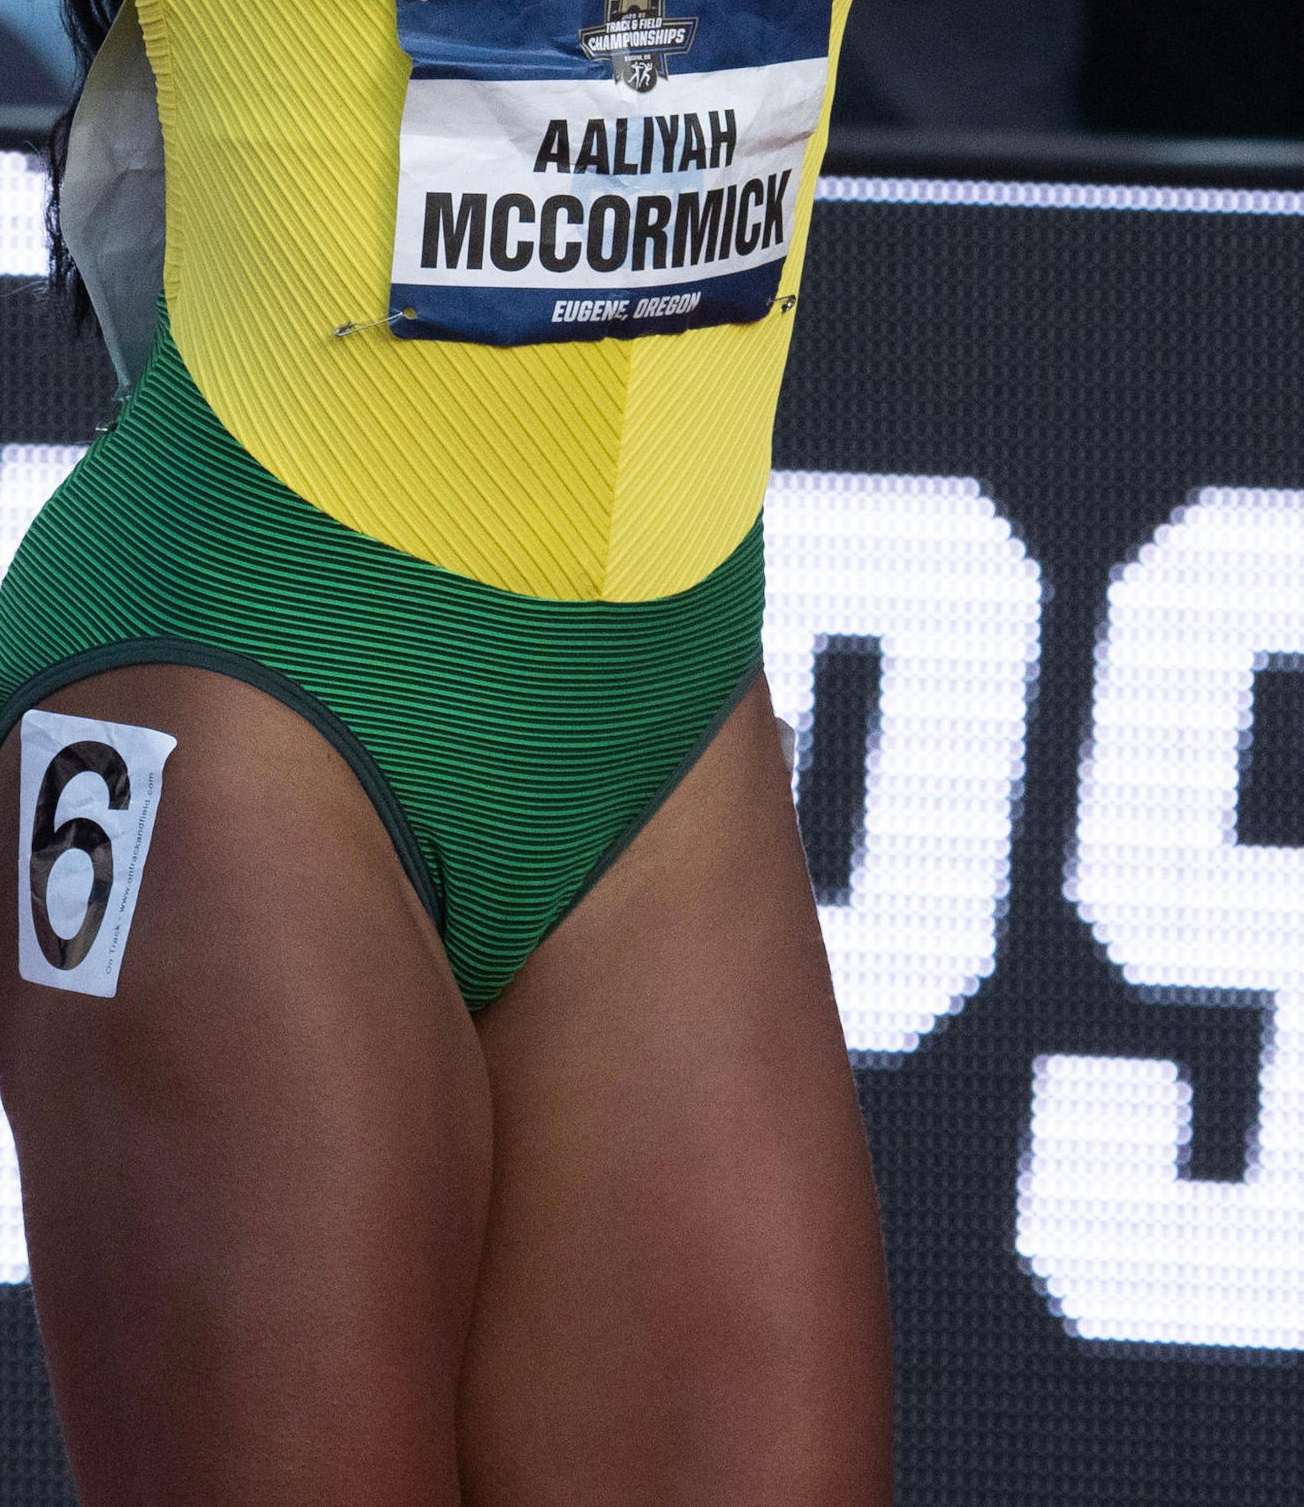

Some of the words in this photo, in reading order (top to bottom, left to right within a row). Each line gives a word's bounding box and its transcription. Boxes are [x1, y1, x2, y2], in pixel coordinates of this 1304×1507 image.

[588, 28, 685, 51] CHAMPIONSHIPS
[606, 20, 632, 33] TRACK
[632, 19, 638, 29] &
[639, 17, 662, 29] FIELD
[533, 109, 737, 175] AALIYAH
[420, 169, 792, 272] MCCORMICK
[551, 300, 630, 322] EUGENE,
[632, 292, 701, 319] OREGON
[30, 740, 130, 970] 6
